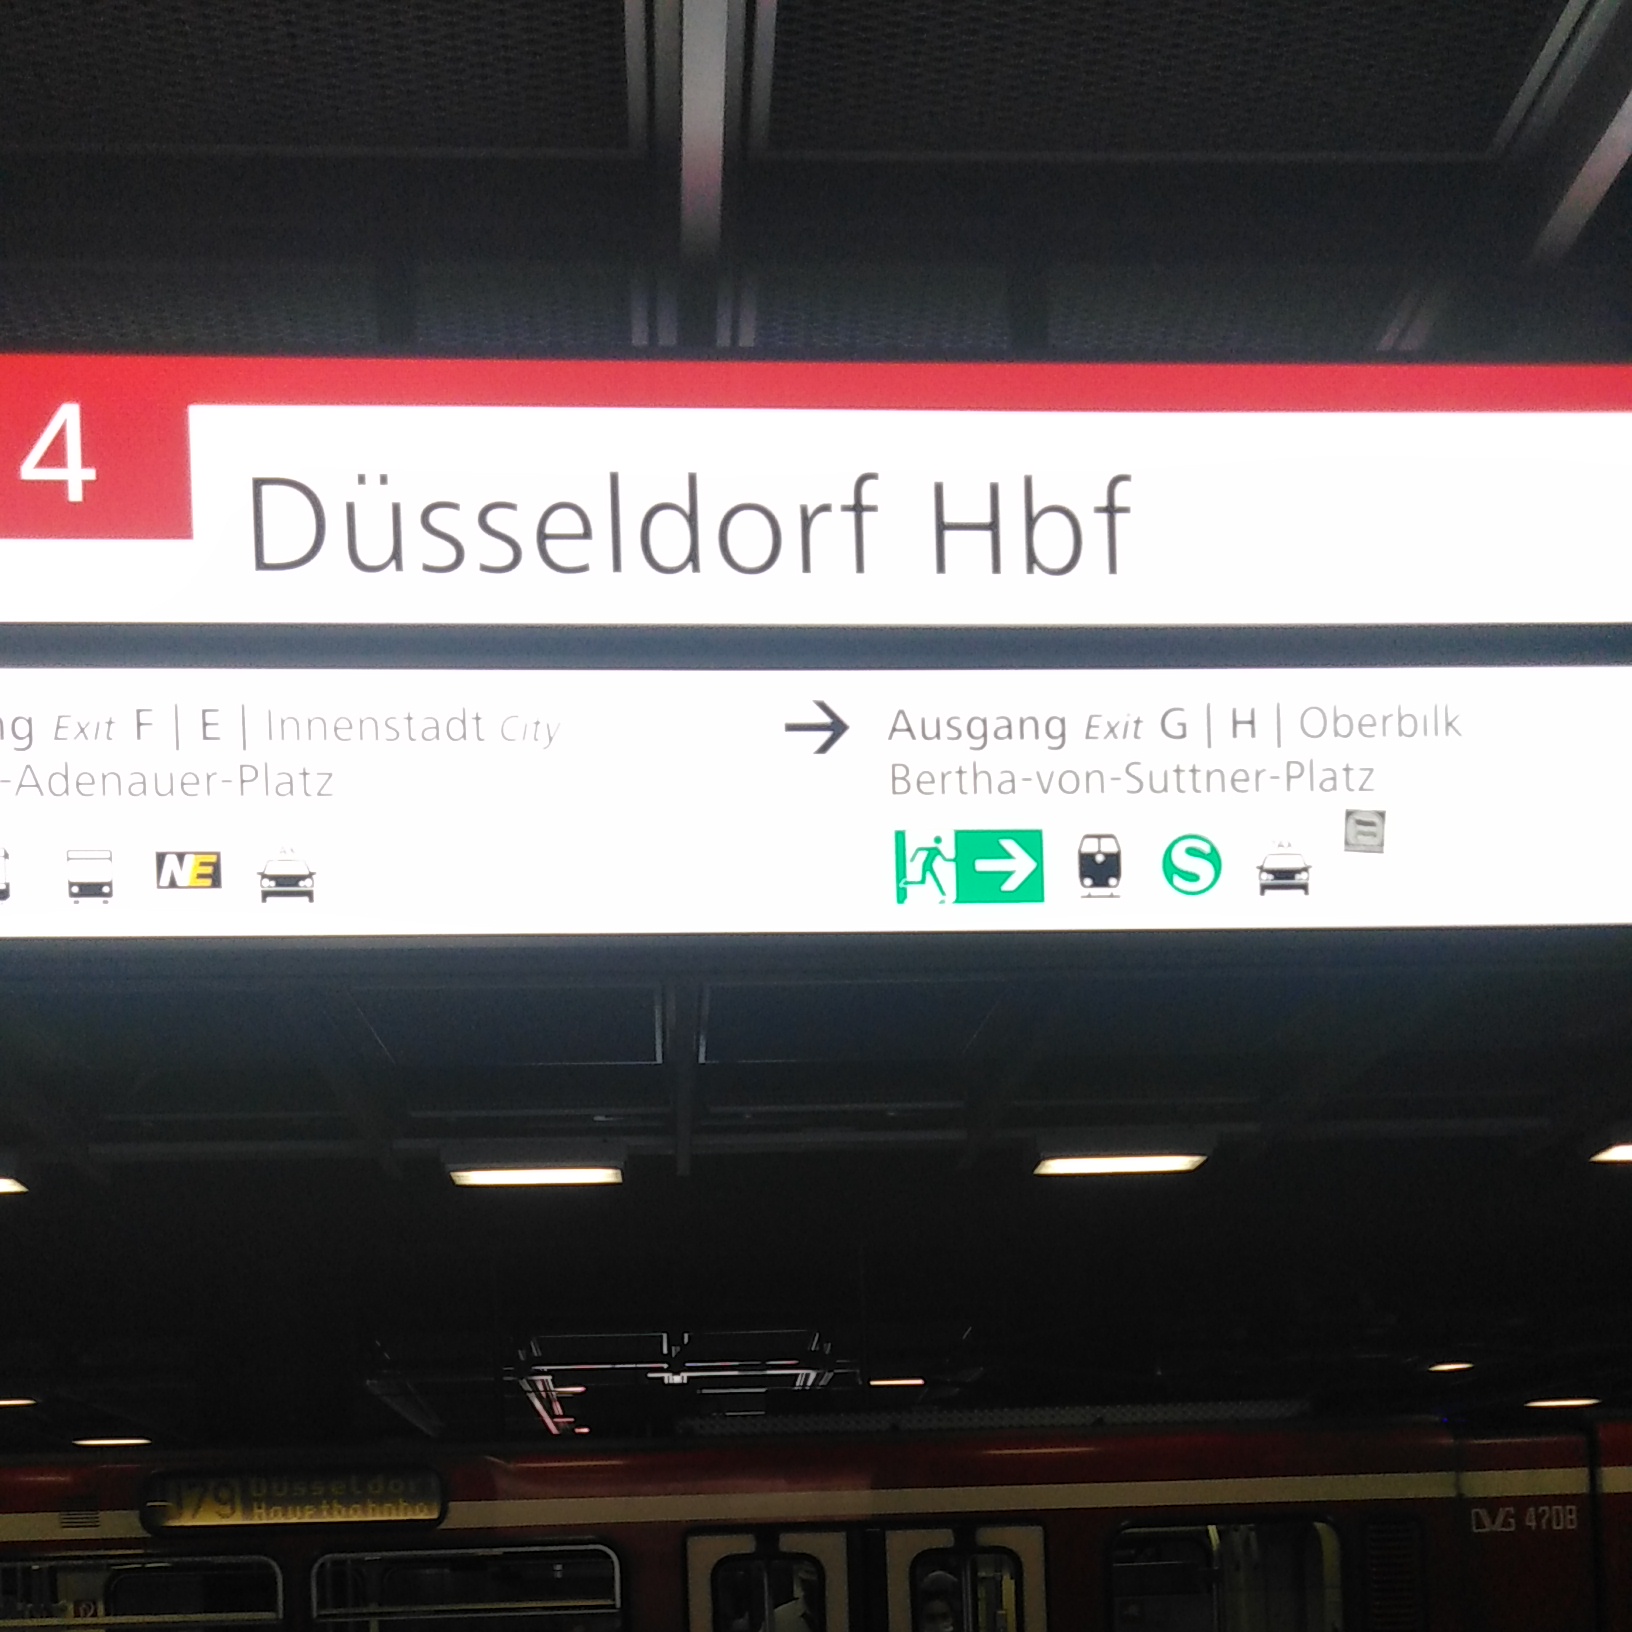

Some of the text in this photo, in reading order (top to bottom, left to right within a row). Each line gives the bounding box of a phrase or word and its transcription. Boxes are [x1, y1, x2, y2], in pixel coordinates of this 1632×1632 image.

[19, 401, 98, 503] 4
[250, 471, 1133, 577] Düsseldorf Hbf
[0, 715, 34, 752] g
[53, 714, 117, 741] Exit
[135, 708, 154, 741] F
[201, 708, 222, 741] E
[267, 707, 486, 742] Innenstadt
[500, 714, 562, 751] City
[887, 708, 1068, 752] Ausgang
[1084, 713, 1145, 741] Exit
[1159, 706, 1189, 741] G
[1230, 707, 1257, 740] H
[1298, 703, 1464, 740] Oberbilk
[890, 758, 1376, 796] Bertha-von-Suttner-Platz
[1525, 1504, 1578, 1531] 4708
